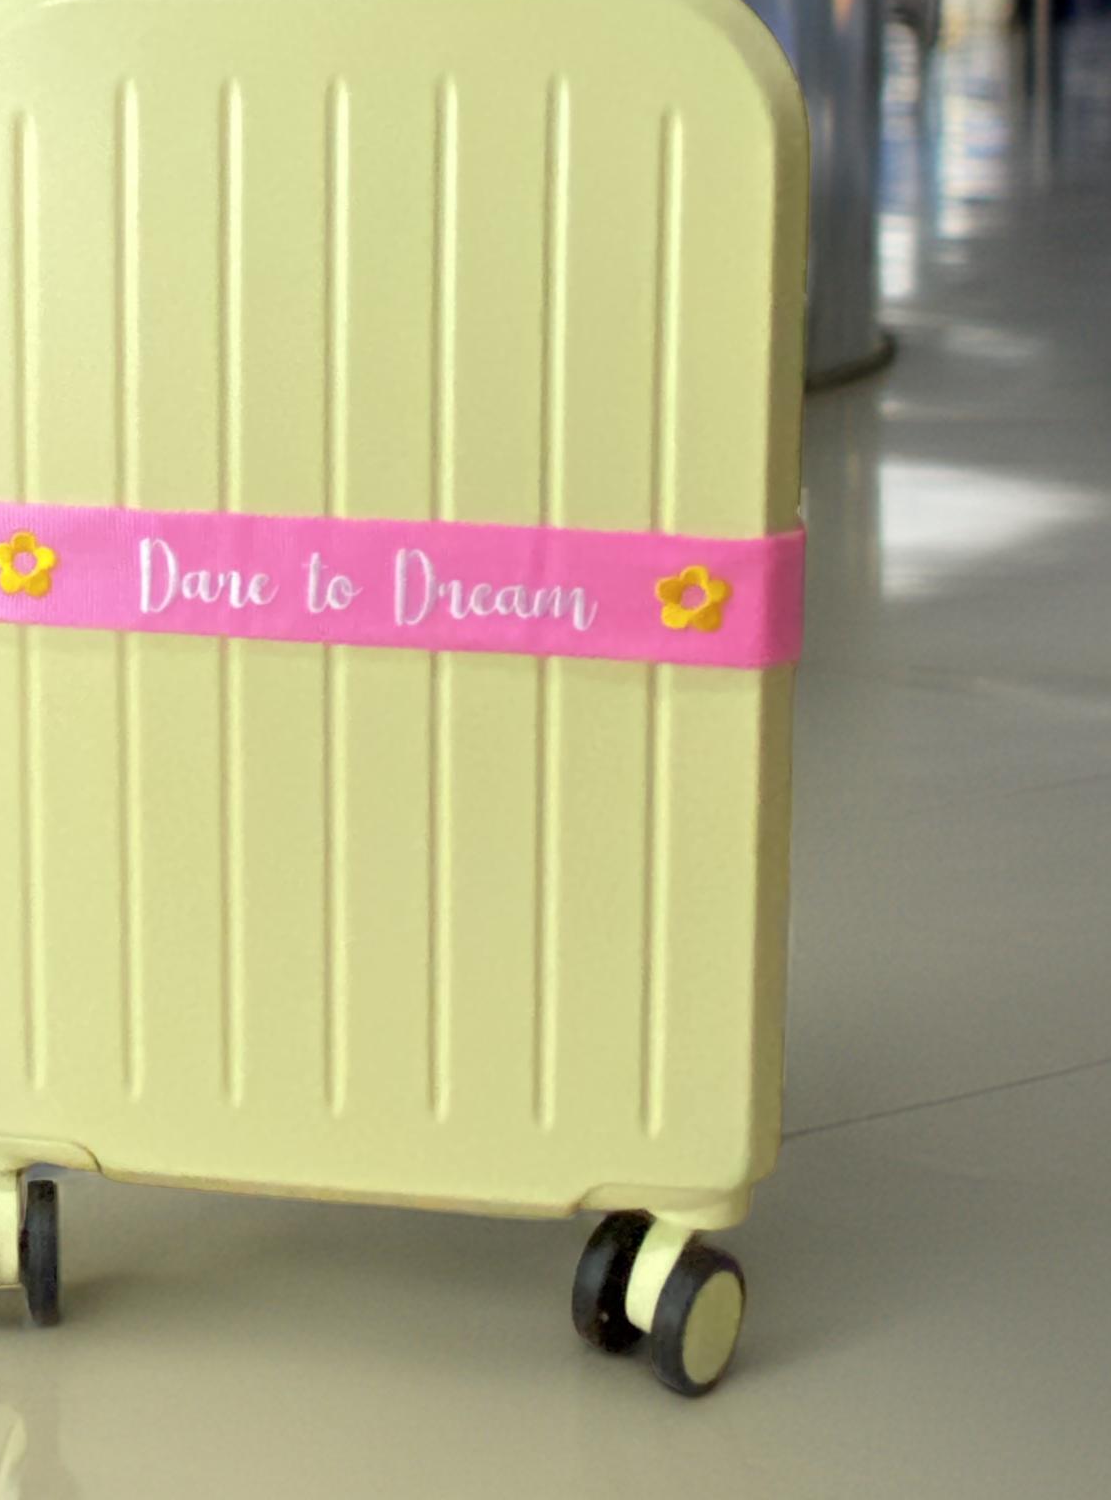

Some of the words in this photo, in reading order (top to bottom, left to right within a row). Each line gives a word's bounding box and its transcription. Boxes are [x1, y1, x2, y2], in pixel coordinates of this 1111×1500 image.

[139, 537, 279, 614] Dare
[302, 551, 364, 614] to
[394, 548, 599, 632] Dream
